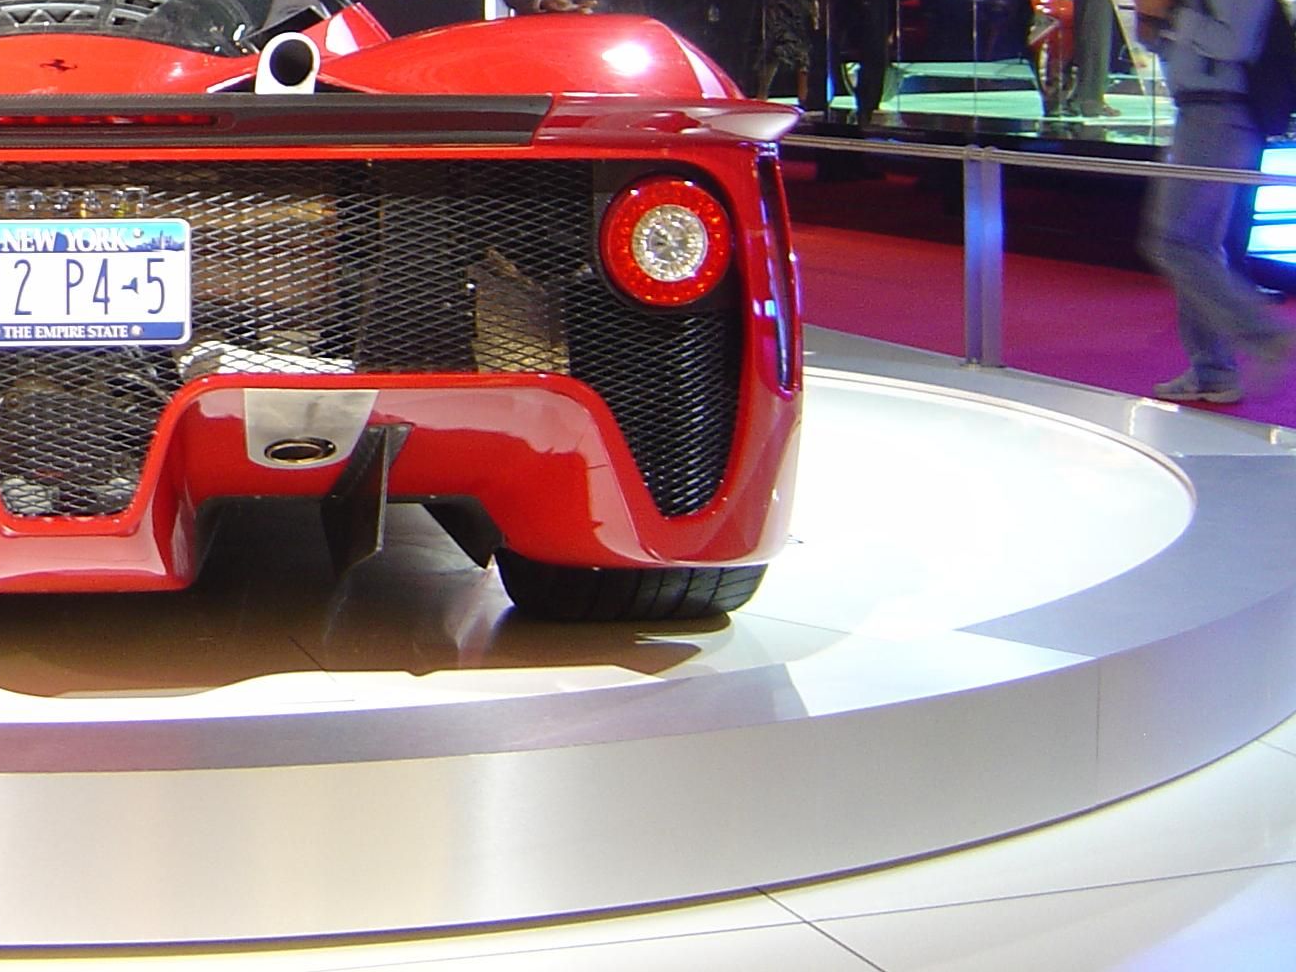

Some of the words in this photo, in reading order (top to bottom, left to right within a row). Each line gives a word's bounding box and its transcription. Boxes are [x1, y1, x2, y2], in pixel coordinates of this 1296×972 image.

[3, 227, 56, 252] NEW
[62, 227, 129, 253] YORK
[2, 325, 32, 338] THE
[35, 325, 85, 338] EMPIRE
[87, 325, 128, 338] STATE
